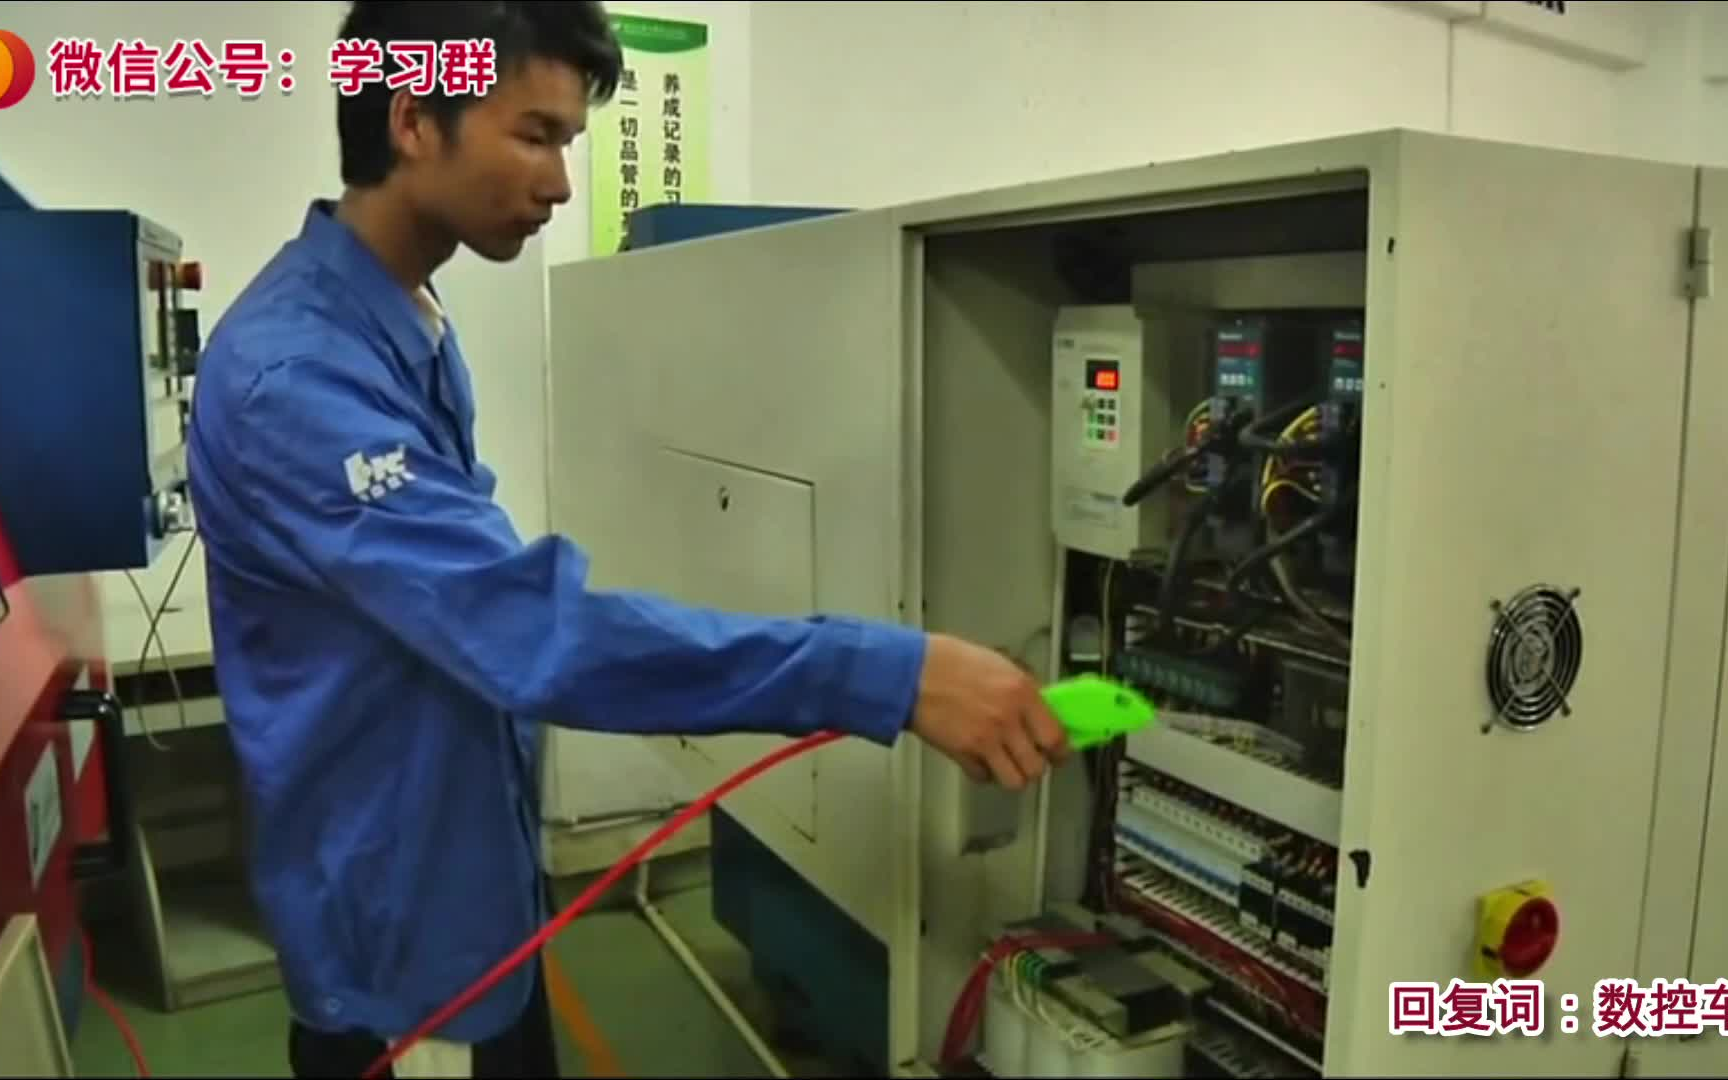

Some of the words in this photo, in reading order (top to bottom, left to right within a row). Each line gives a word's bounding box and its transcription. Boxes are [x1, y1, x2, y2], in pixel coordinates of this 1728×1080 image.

[620, 69, 638, 232] 是一切品管的
